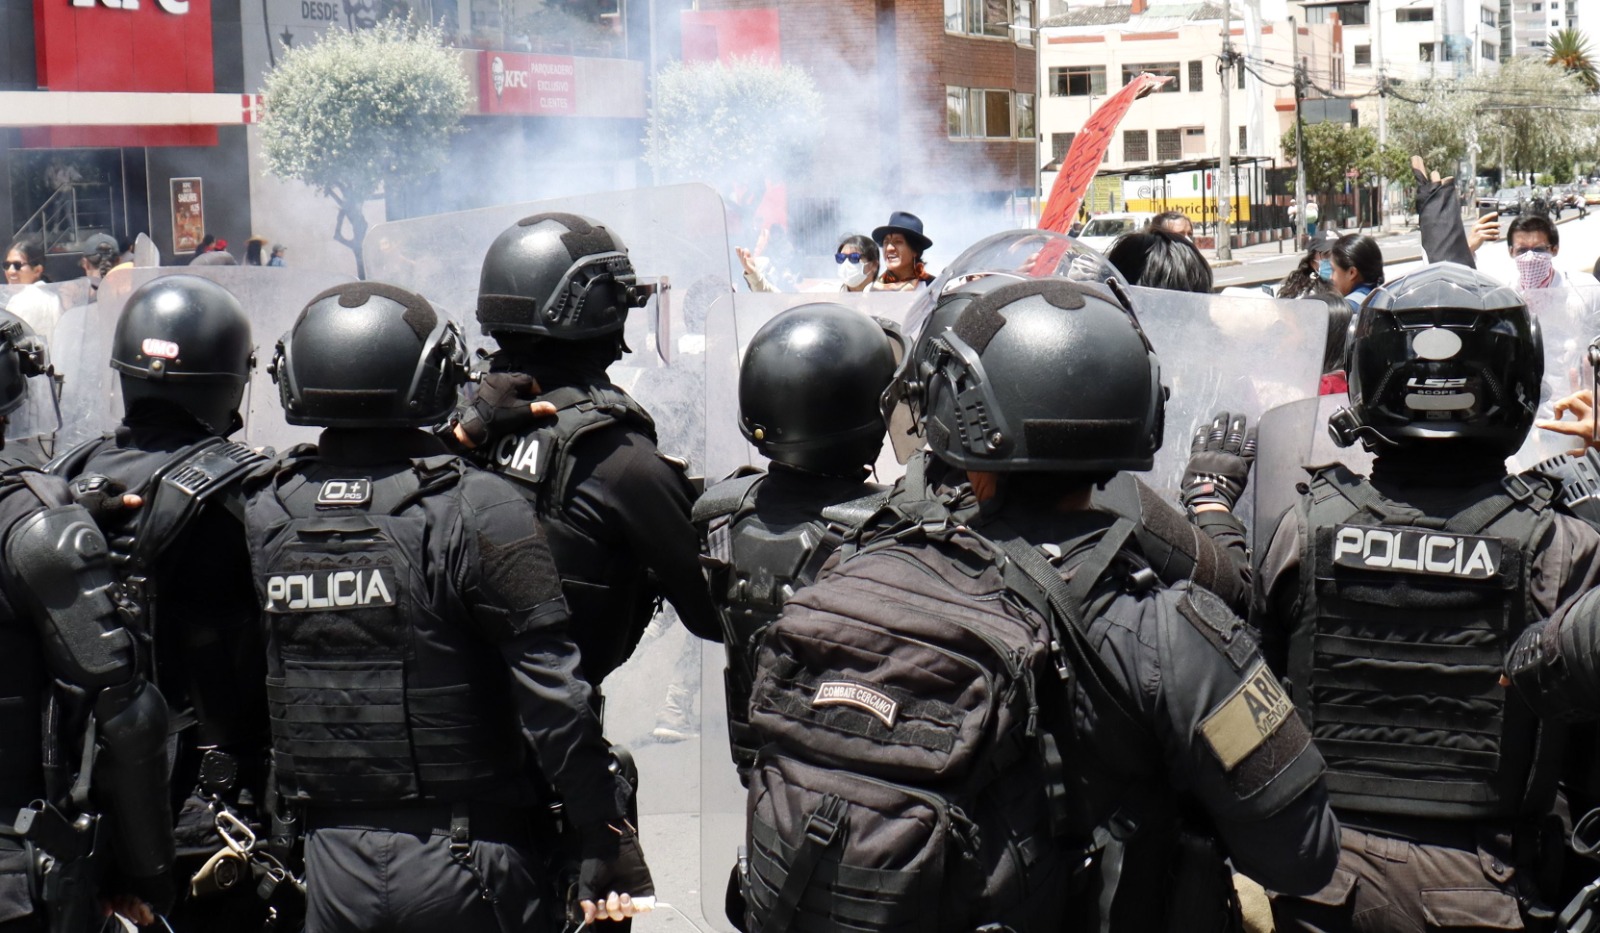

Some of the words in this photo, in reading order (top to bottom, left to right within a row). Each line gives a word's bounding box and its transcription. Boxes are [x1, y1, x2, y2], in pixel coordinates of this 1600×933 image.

[301, 1, 338, 21] DESDE
[530, 63, 573, 76] PARQUEADERO
[504, 70, 528, 88] KFC
[537, 80, 568, 91] EXCLUSIVO
[540, 97, 567, 108] CLIENTES
[1137, 180, 1172, 199] eni
[1407, 377, 1467, 388] LS2
[264, 568, 392, 610] POLICIA
[823, 686, 857, 699] COMBATE
[856, 689, 891, 714] CERCANO
